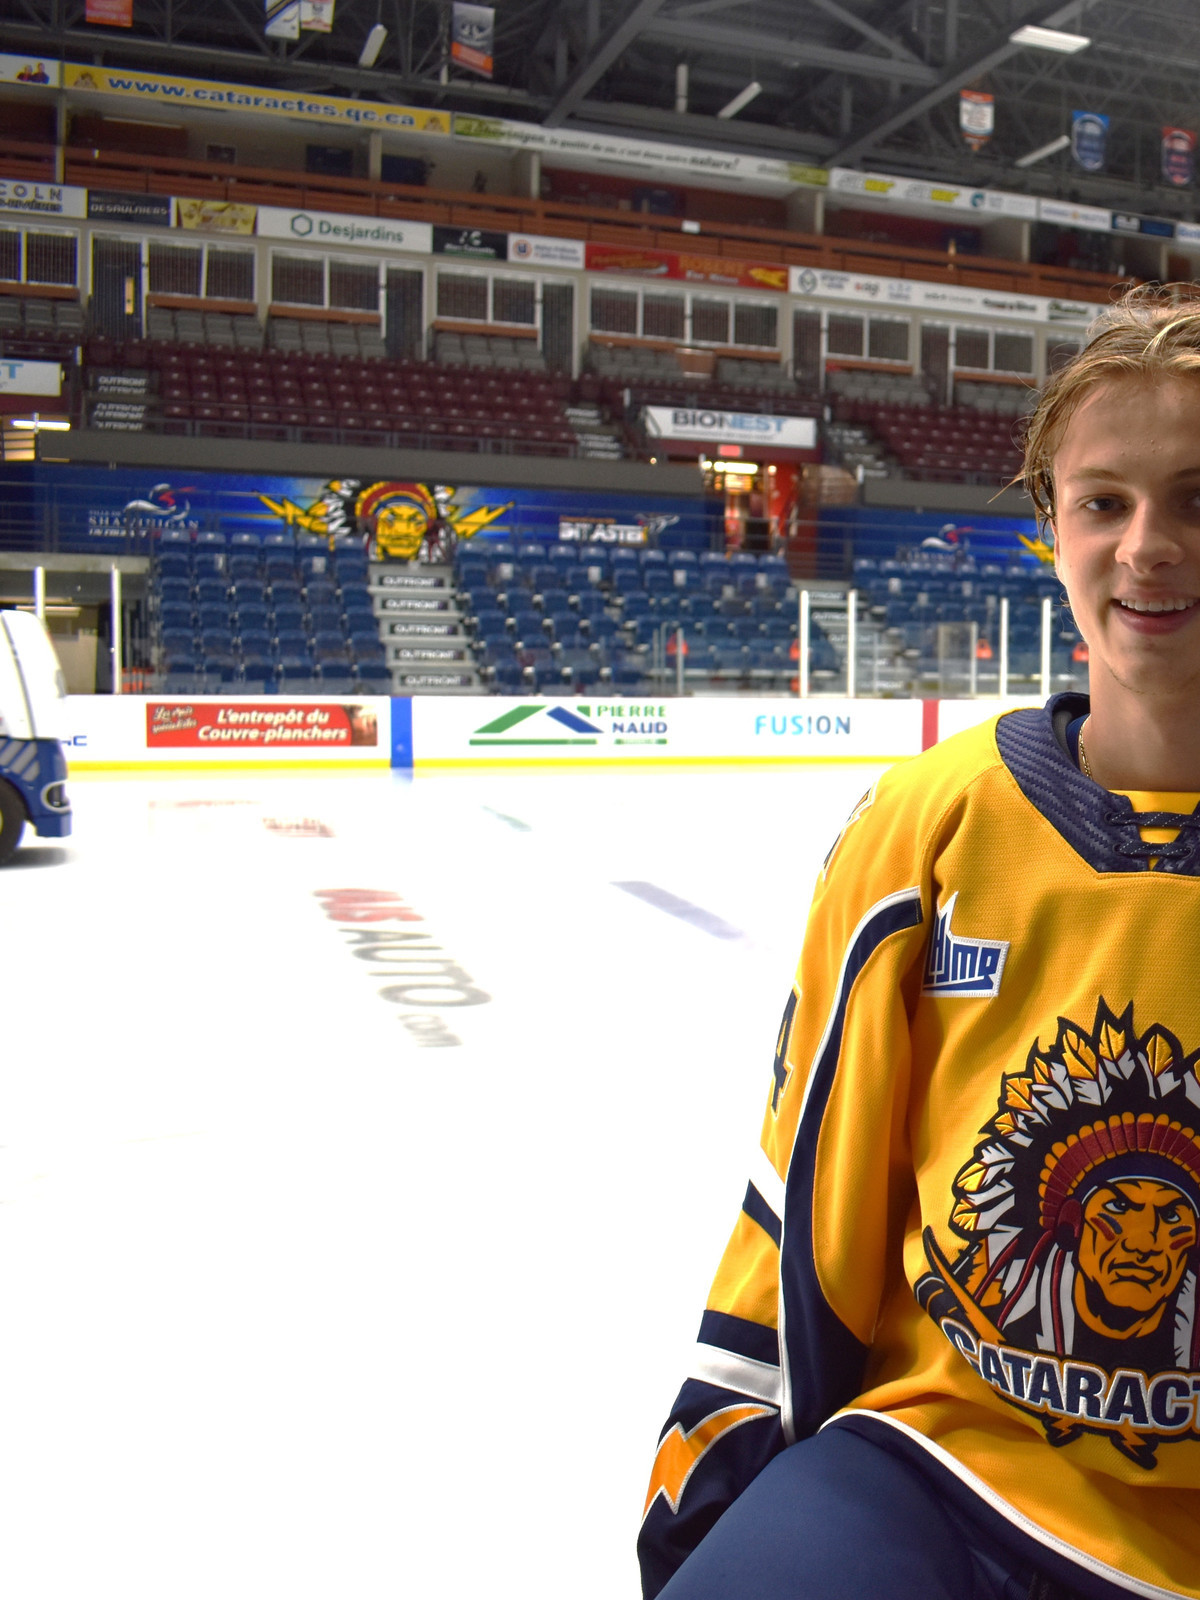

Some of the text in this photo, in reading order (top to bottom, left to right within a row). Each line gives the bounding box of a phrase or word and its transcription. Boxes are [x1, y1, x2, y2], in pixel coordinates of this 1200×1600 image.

[108, 77, 415, 127] www.cataractes.qc.ca
[318, 220, 404, 244] Desjardins
[0, 363, 24, 379] T
[672, 410, 788, 432] BIONEST
[217, 708, 330, 728] L'entrepôt du
[597, 705, 667, 718] PIERRE
[198, 725, 348, 744] Couvre-planchers
[612, 721, 668, 734] NAUD
[755, 715, 851, 736] FUSION
[337, 928, 493, 1008] AUTO
[770, 980, 801, 1120] 4
